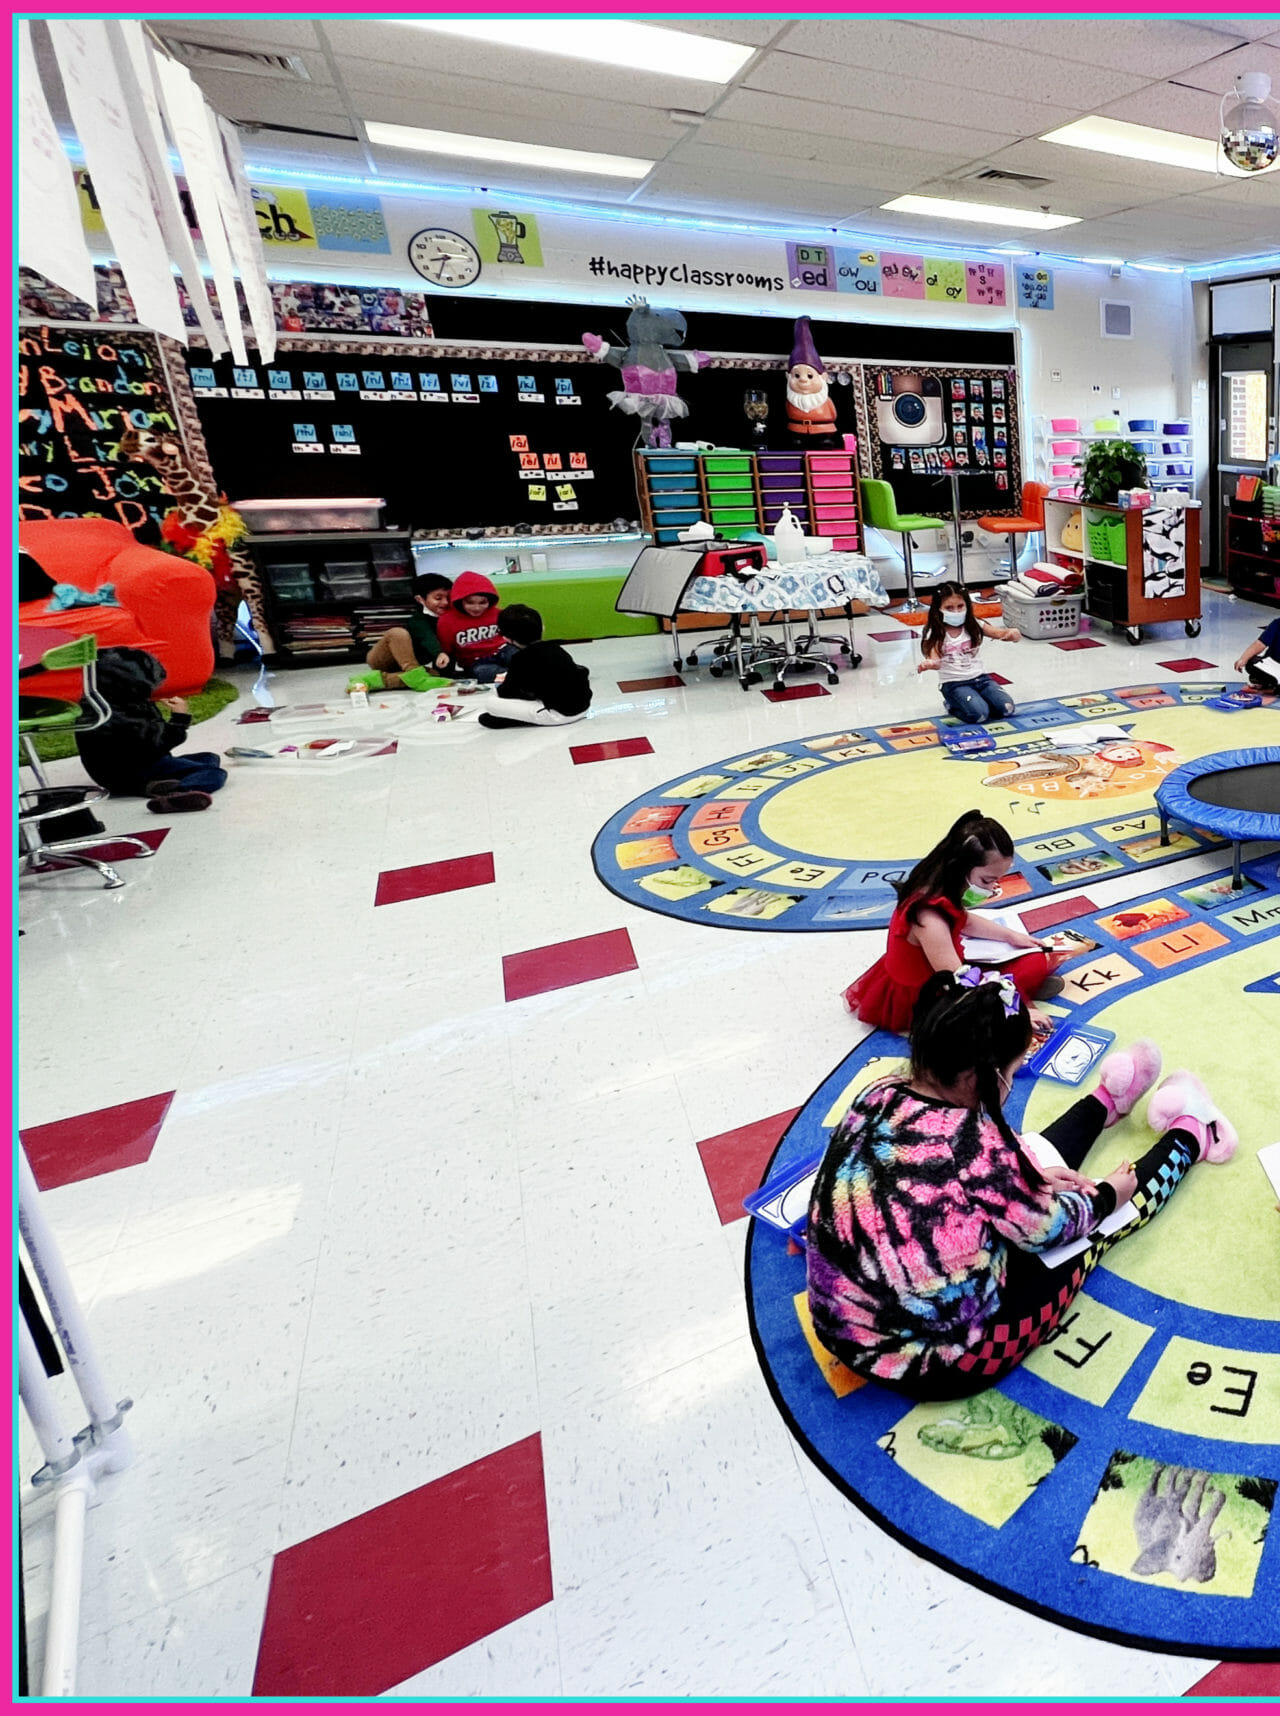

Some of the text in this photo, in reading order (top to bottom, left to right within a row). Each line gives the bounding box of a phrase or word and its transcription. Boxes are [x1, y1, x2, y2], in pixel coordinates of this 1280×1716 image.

[800, 250, 823, 261] D T
[589, 256, 784, 292] #happyclassrooms
[802, 269, 828, 287] ed
[839, 267, 859, 278] ow
[883, 264, 919, 281] eu ew
[855, 280, 877, 293] ou
[946, 287, 962, 299] oy
[39, 366, 162, 395] Brandon
[307, 378, 324, 388] /g/
[340, 377, 356, 388] /s/
[520, 381, 534, 389] /k/
[557, 383, 570, 392] /p/
[49, 393, 177, 432] Miriam
[571, 456, 585, 464] /o/
[840, 748, 868, 758] Kk
[1018, 781, 1060, 793] Bb
[705, 806, 737, 821] Hh
[1112, 820, 1146, 832] Aa
[703, 827, 739, 847] Gg
[1035, 838, 1075, 853] Bb
[727, 852, 764, 867] Ff
[790, 868, 825, 882] Ee
[861, 871, 906, 884] Dd
[1162, 934, 1200, 954] Ll
[1070, 969, 1120, 992] Kk
[1045, 1312, 1112, 1368] Ff
[1187, 1362, 1258, 1417] Ee
